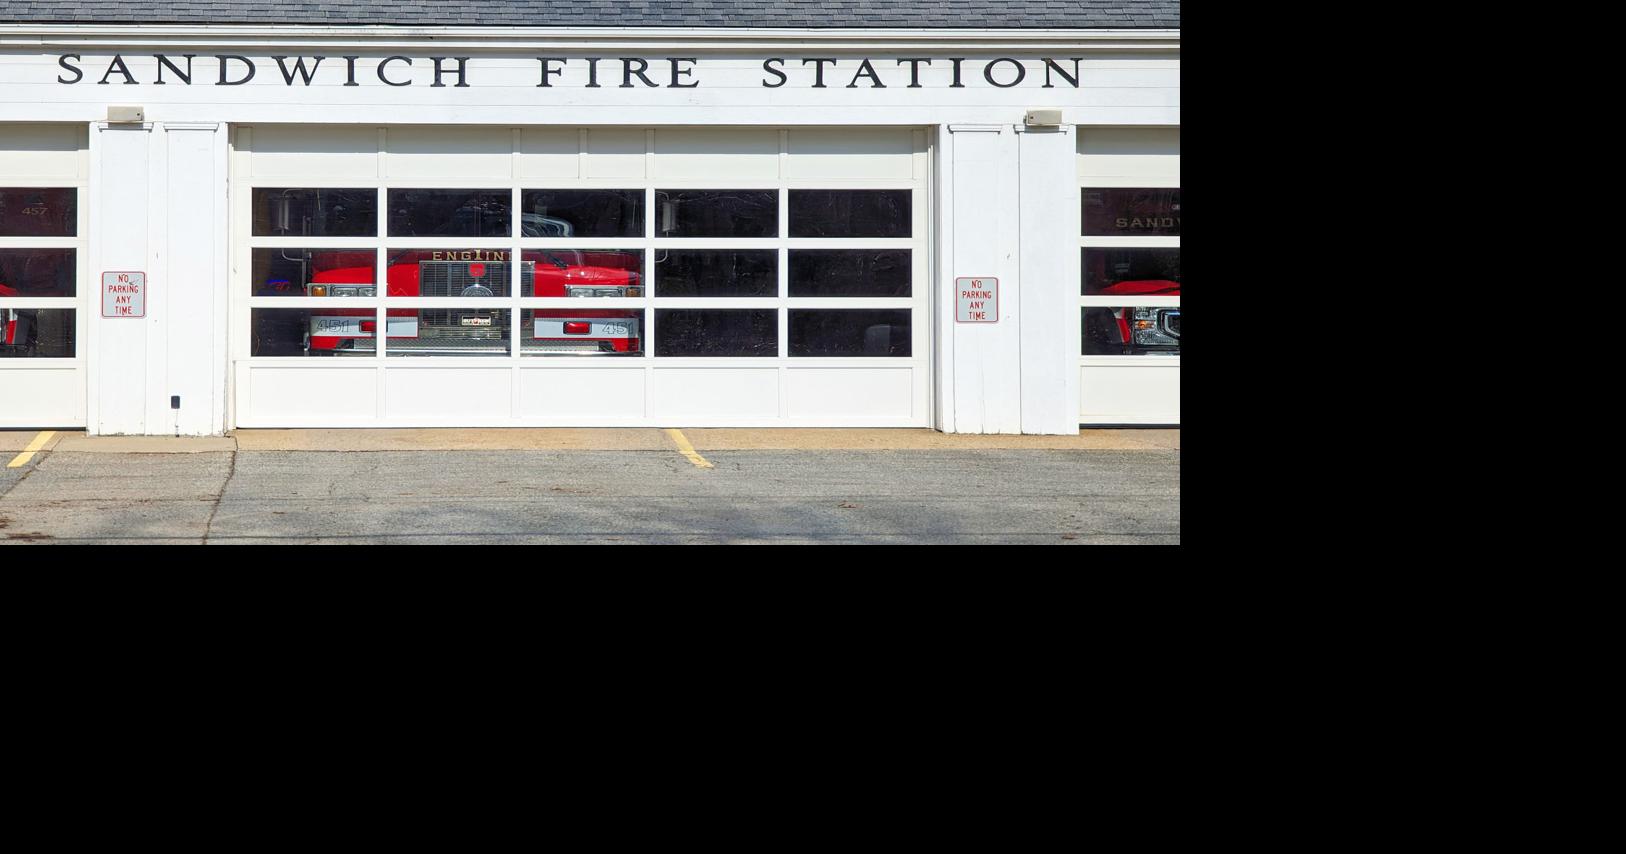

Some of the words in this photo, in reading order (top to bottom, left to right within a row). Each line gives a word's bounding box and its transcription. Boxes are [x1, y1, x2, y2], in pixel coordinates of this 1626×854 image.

[57, 53, 472, 88] SANDWICH
[536, 56, 700, 88] FIRE
[762, 57, 1084, 88] STATION
[22, 207, 49, 215] 457
[1115, 217, 1180, 228] SAND
[118, 274, 129, 283] NO
[108, 285, 139, 293] PARKING
[971, 280, 982, 289] NO
[116, 295, 131, 304] ANY
[962, 291, 992, 299] PARKING
[969, 301, 984, 309] ANY
[115, 306, 132, 315] TIME
[969, 312, 986, 320] TIME
[317, 319, 350, 333] 451
[602, 321, 634, 335] 451
